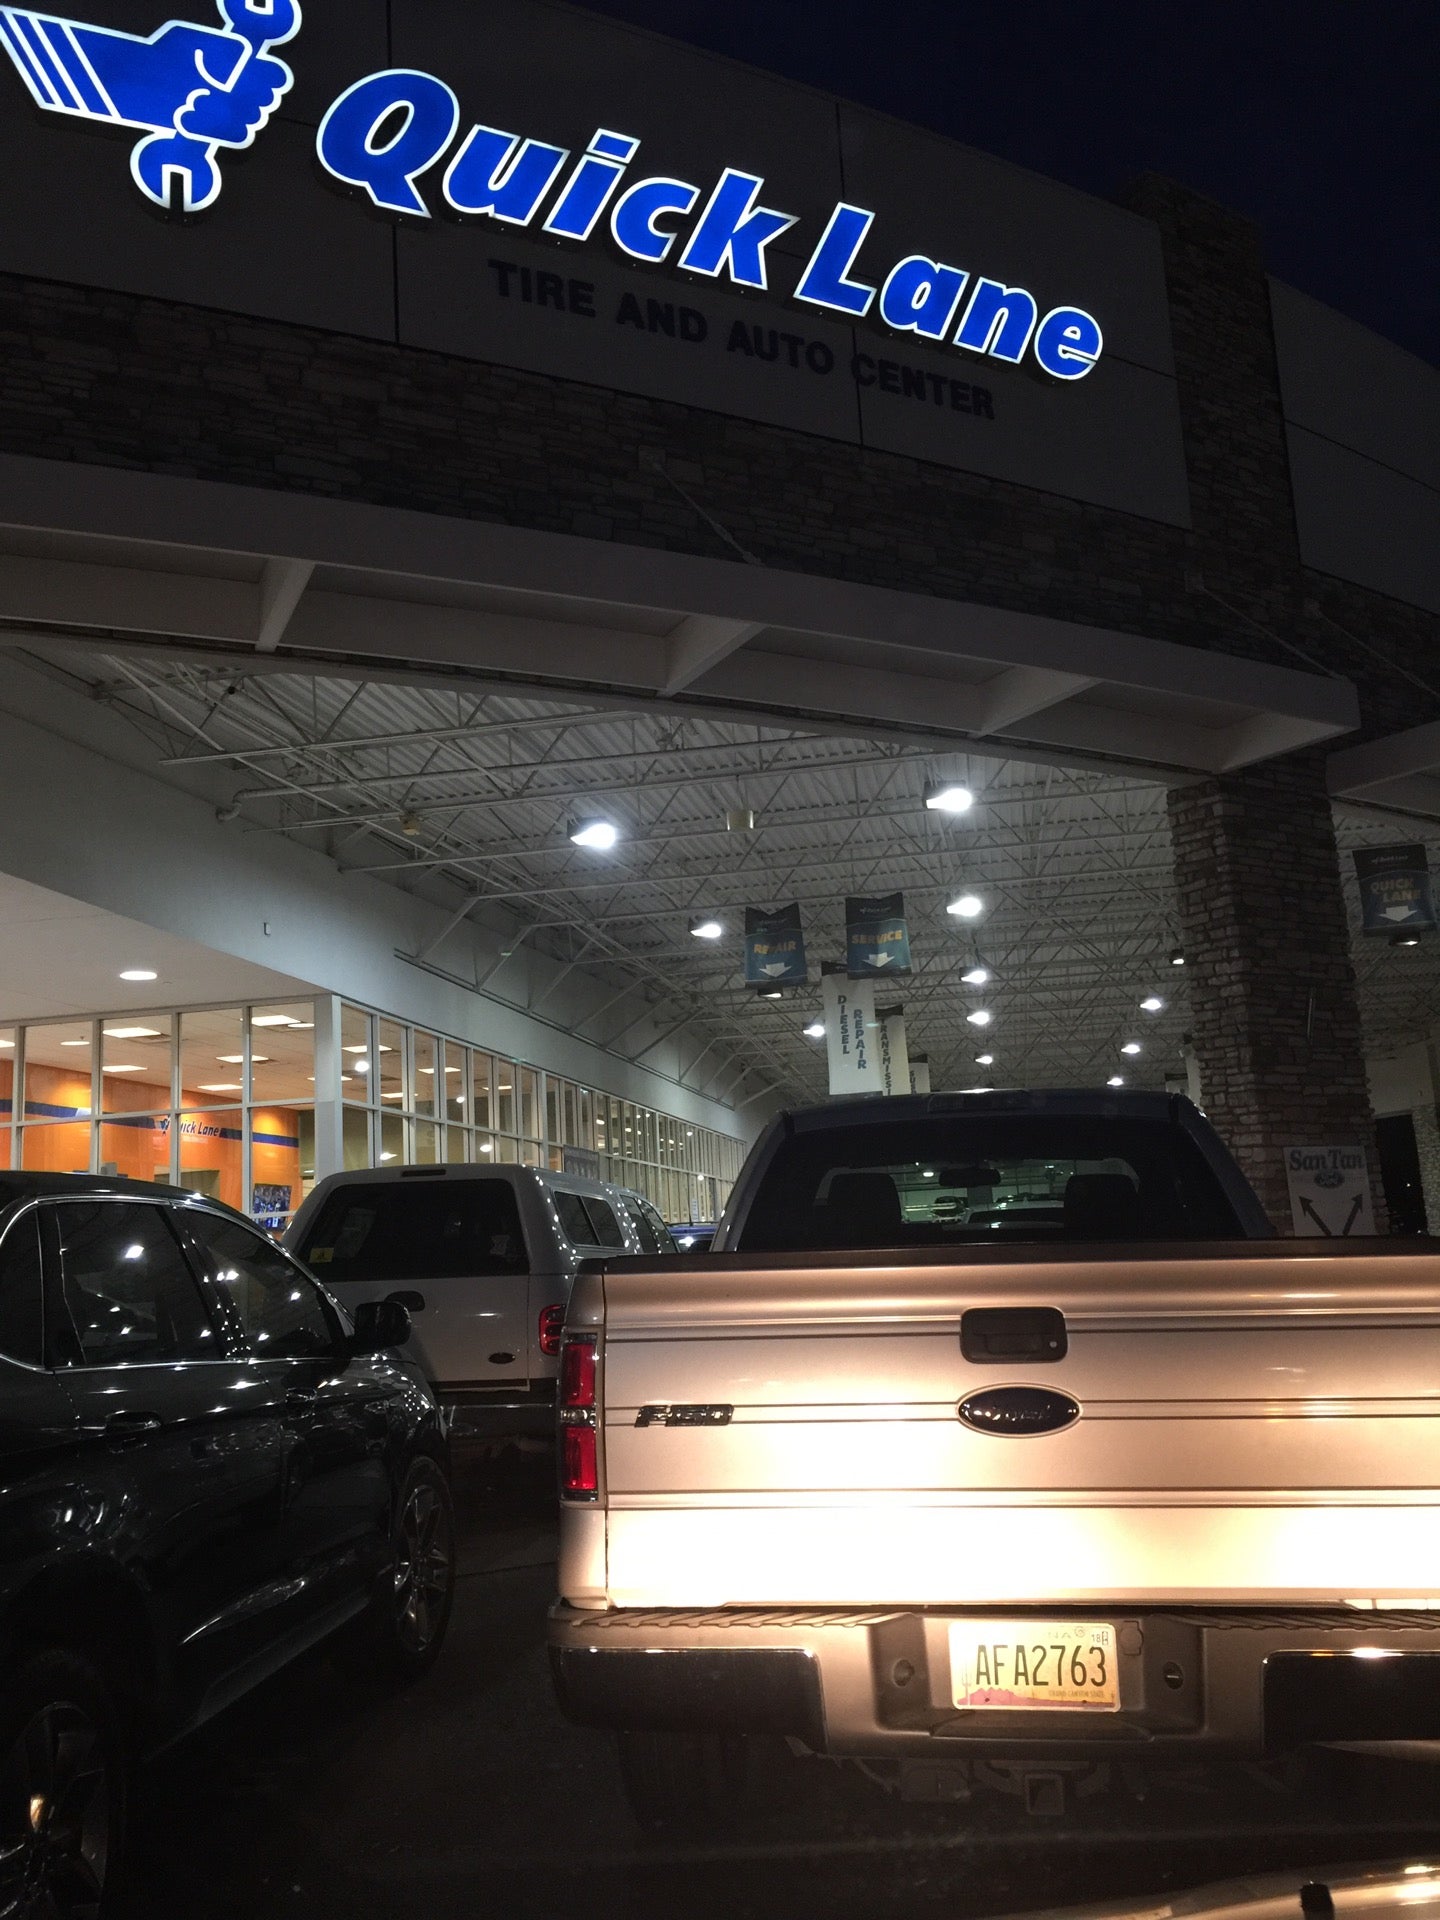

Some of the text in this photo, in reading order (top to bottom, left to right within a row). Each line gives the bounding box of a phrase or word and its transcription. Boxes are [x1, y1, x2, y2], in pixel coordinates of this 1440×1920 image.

[316, 68, 1104, 381] Quick Lane
[488, 258, 996, 422] TIRE AND AUTO CENTER
[851, 929, 903, 944] SERVICE
[837, 995, 850, 1055] DIESEL
[853, 1009, 867, 1070] REPAIR
[197, 1121, 219, 1137] Lane
[976, 1644, 1107, 1688] AFA2763
